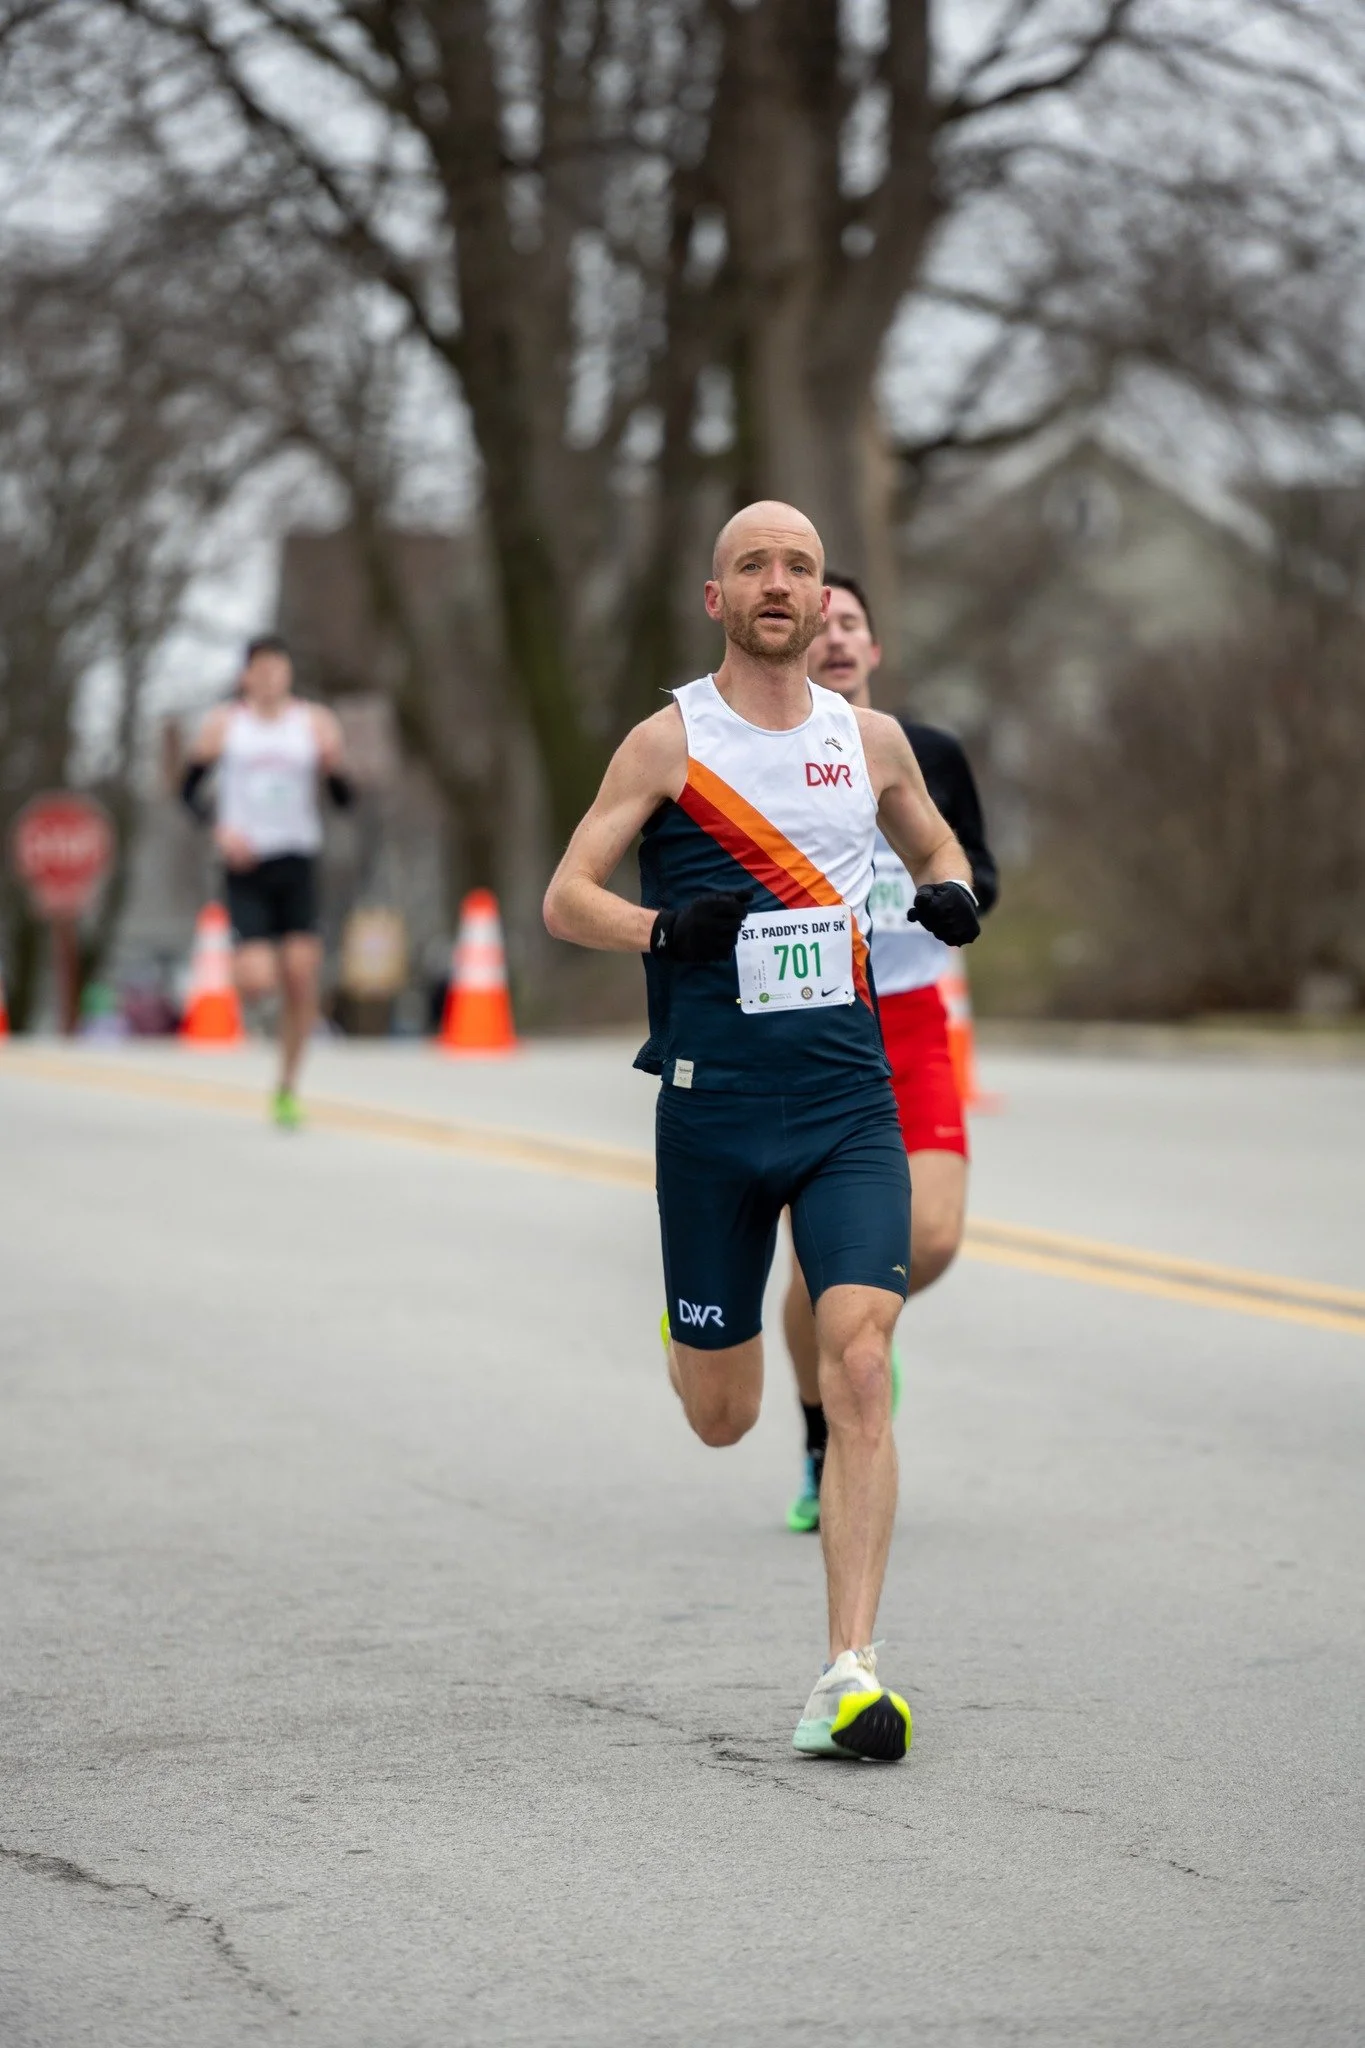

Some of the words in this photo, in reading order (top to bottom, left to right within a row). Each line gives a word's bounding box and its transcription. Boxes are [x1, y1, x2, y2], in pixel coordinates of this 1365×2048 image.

[805, 762, 853, 788] DWR
[741, 929, 759, 941] ST.
[761, 923, 809, 939] PADDY'S
[811, 921, 831, 934] DAY
[833, 920, 846, 932] 5K
[773, 941, 821, 981] 701
[678, 1297, 726, 1328] DWR
